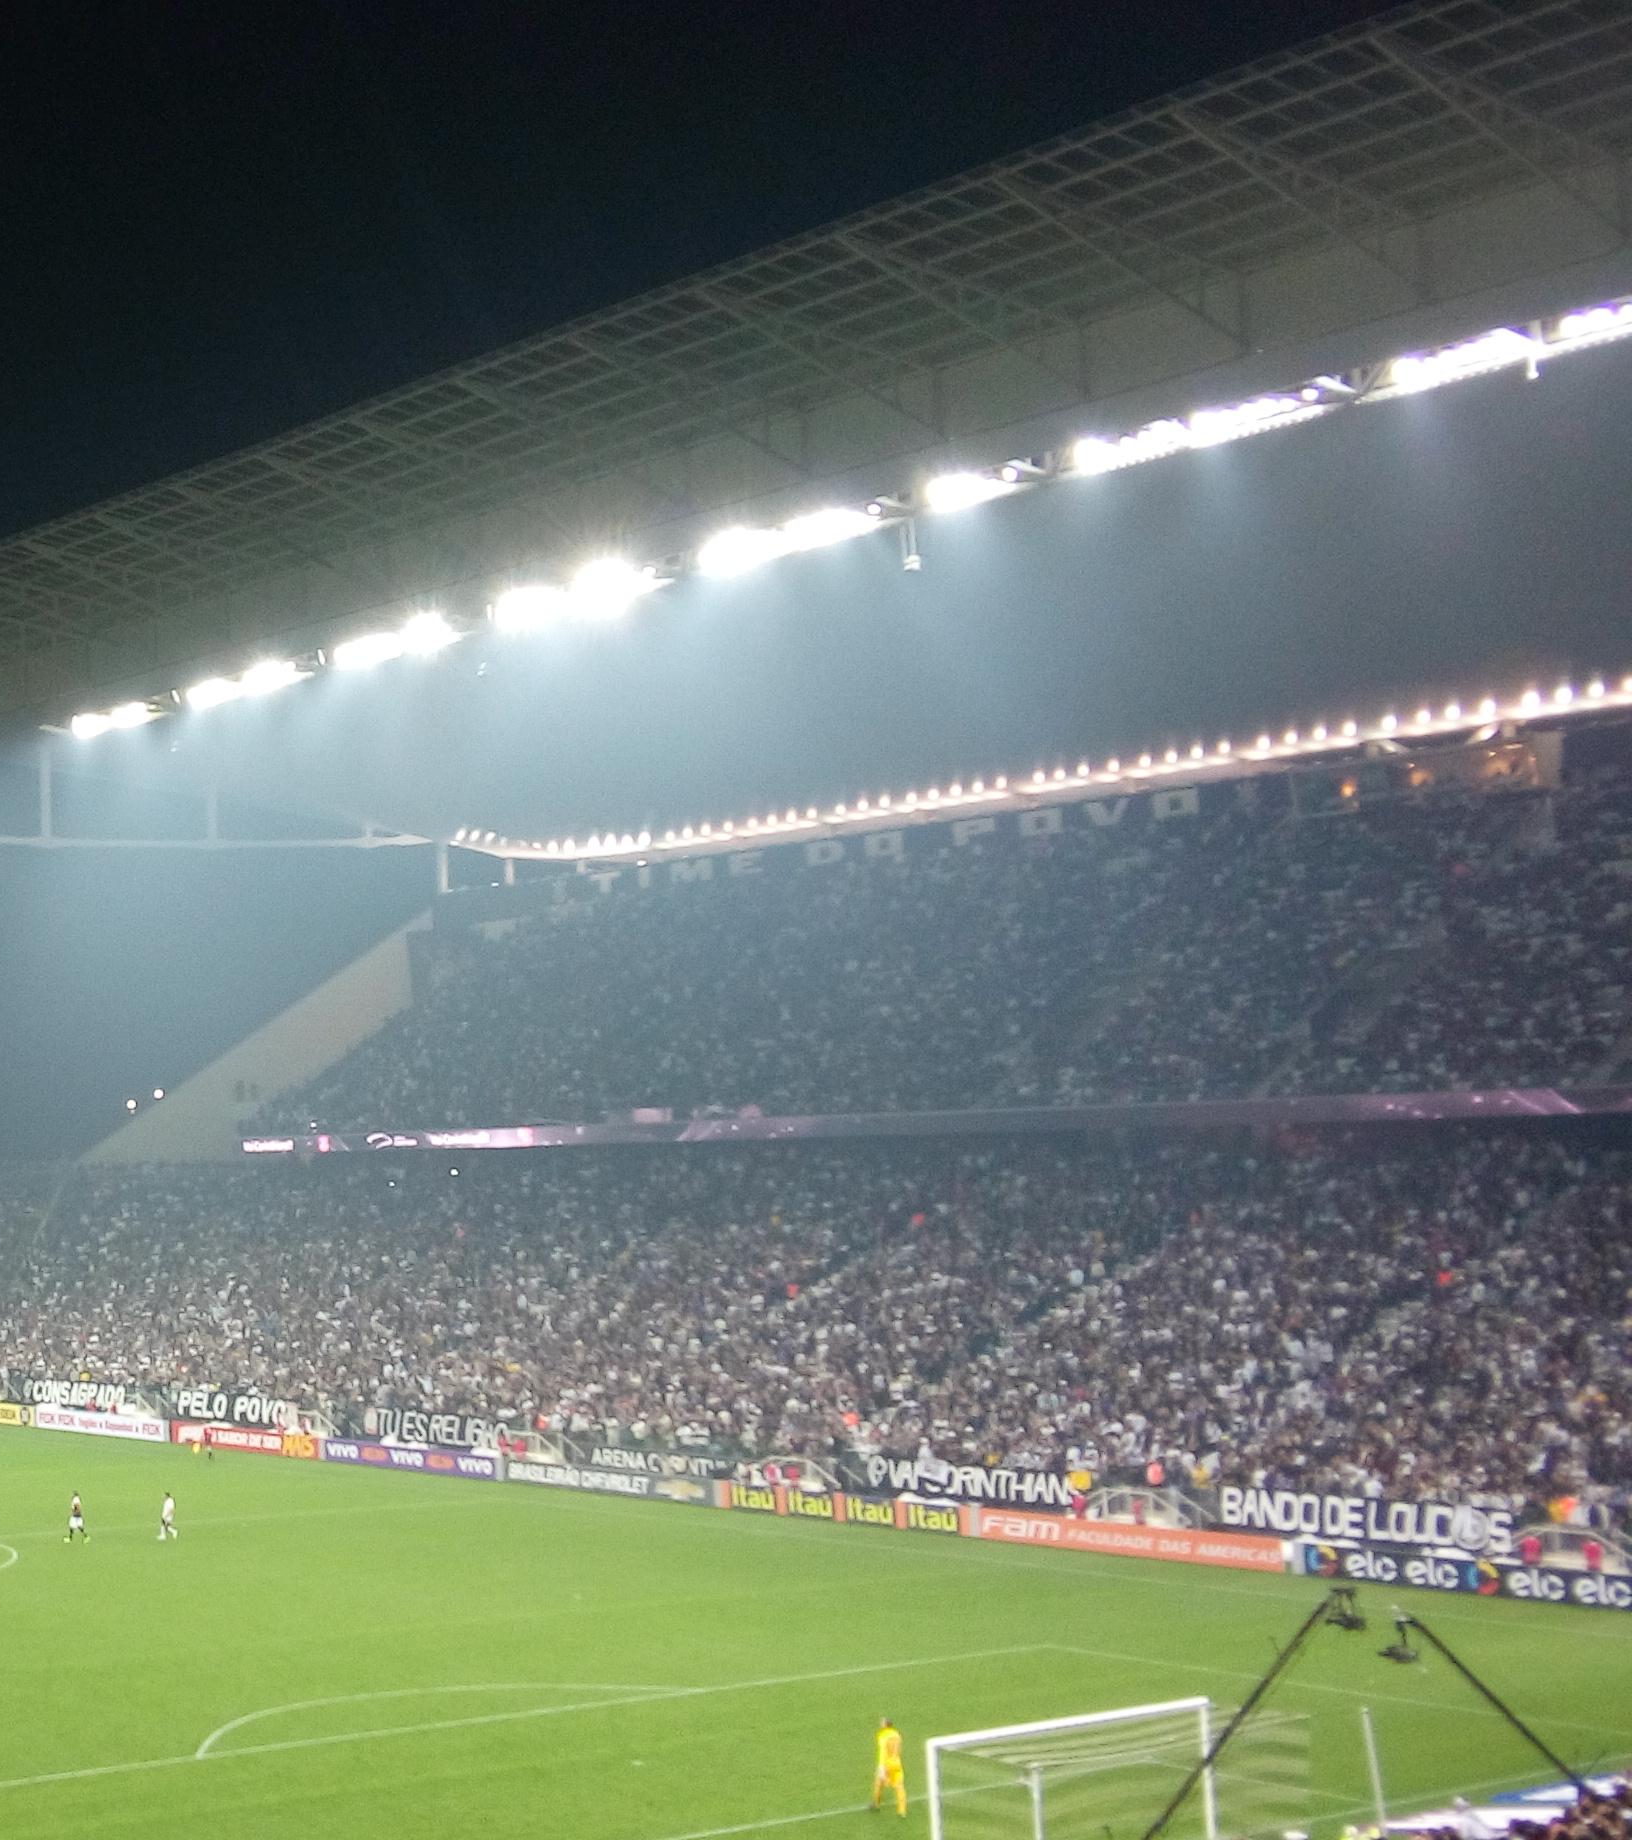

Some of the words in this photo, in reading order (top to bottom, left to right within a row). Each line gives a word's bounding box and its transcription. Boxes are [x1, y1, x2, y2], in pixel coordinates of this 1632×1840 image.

[952, 787, 1200, 846] POVO
[177, 1390, 228, 1419] PELO
[590, 1447, 648, 1471] ARENA
[1221, 1487, 1321, 1533] BANDO
[1323, 1494, 1366, 1538] DE
[1069, 1530, 1153, 1552] FACULDADE
[1158, 1539, 1192, 1556] DAS
